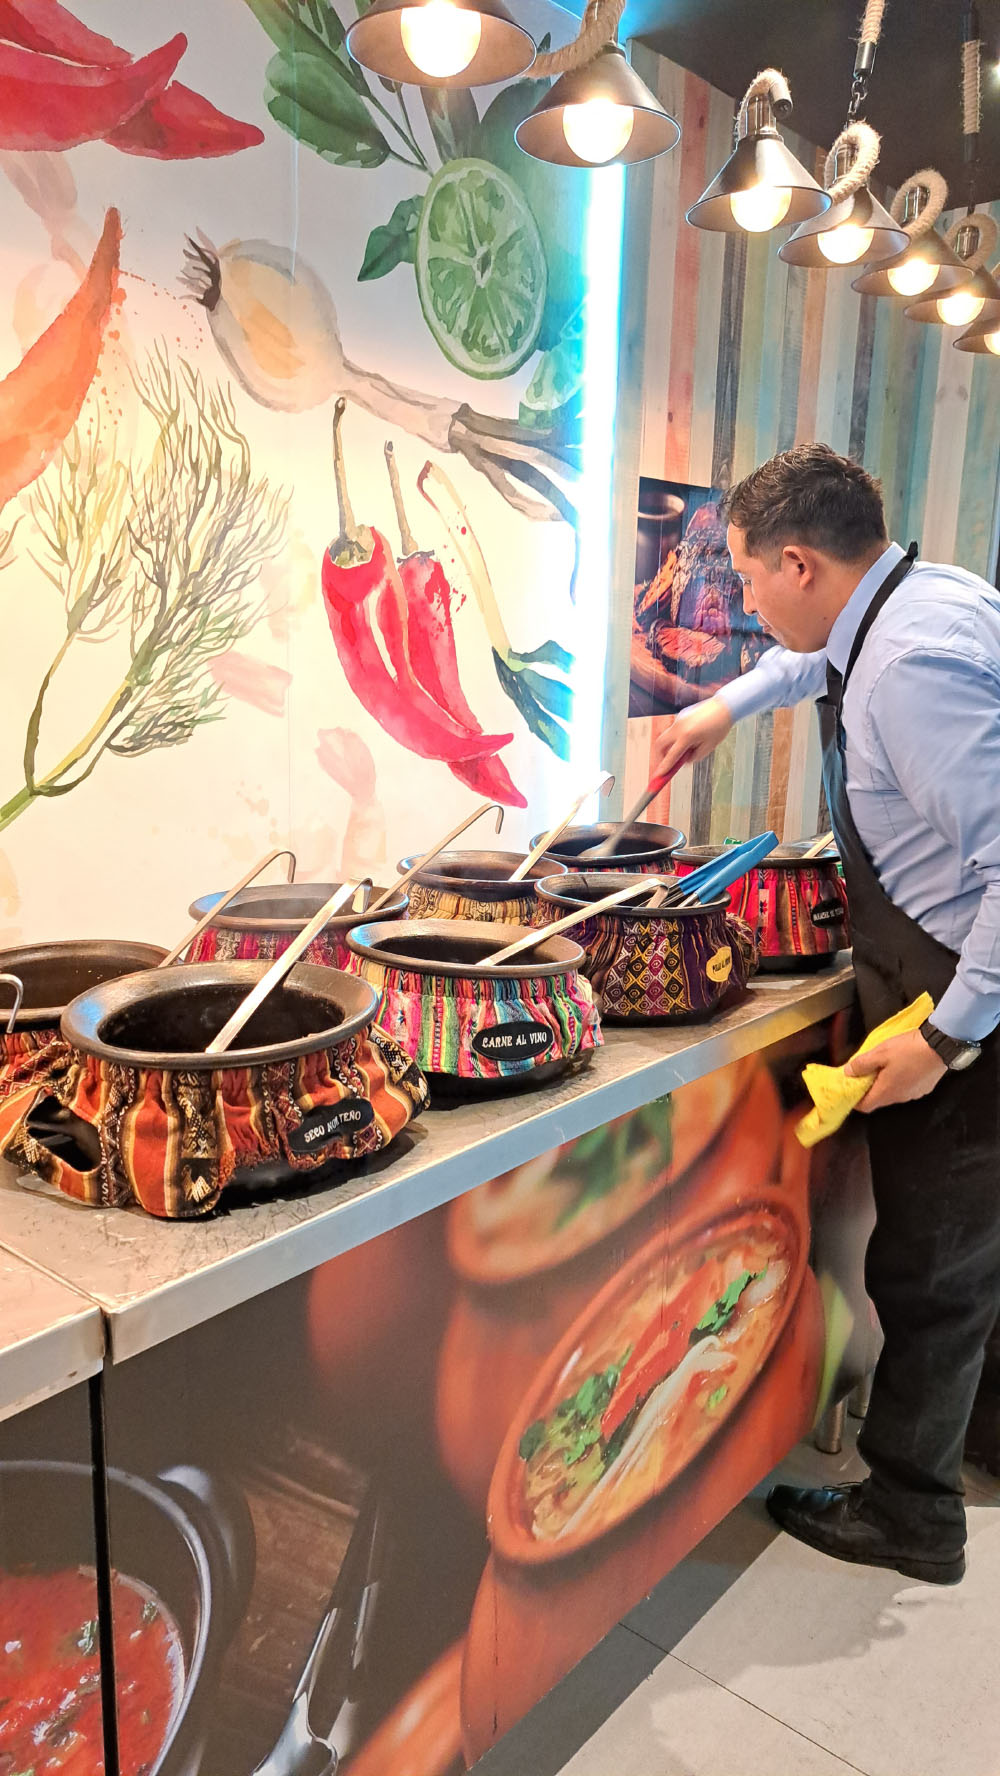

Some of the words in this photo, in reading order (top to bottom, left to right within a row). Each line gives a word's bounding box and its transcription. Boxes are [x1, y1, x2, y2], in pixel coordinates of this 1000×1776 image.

[481, 1035, 513, 1048] CARNE
[515, 1033, 527, 1046] AL
[529, 1031, 548, 1045] VINO
[303, 1124, 325, 1144] SECO
